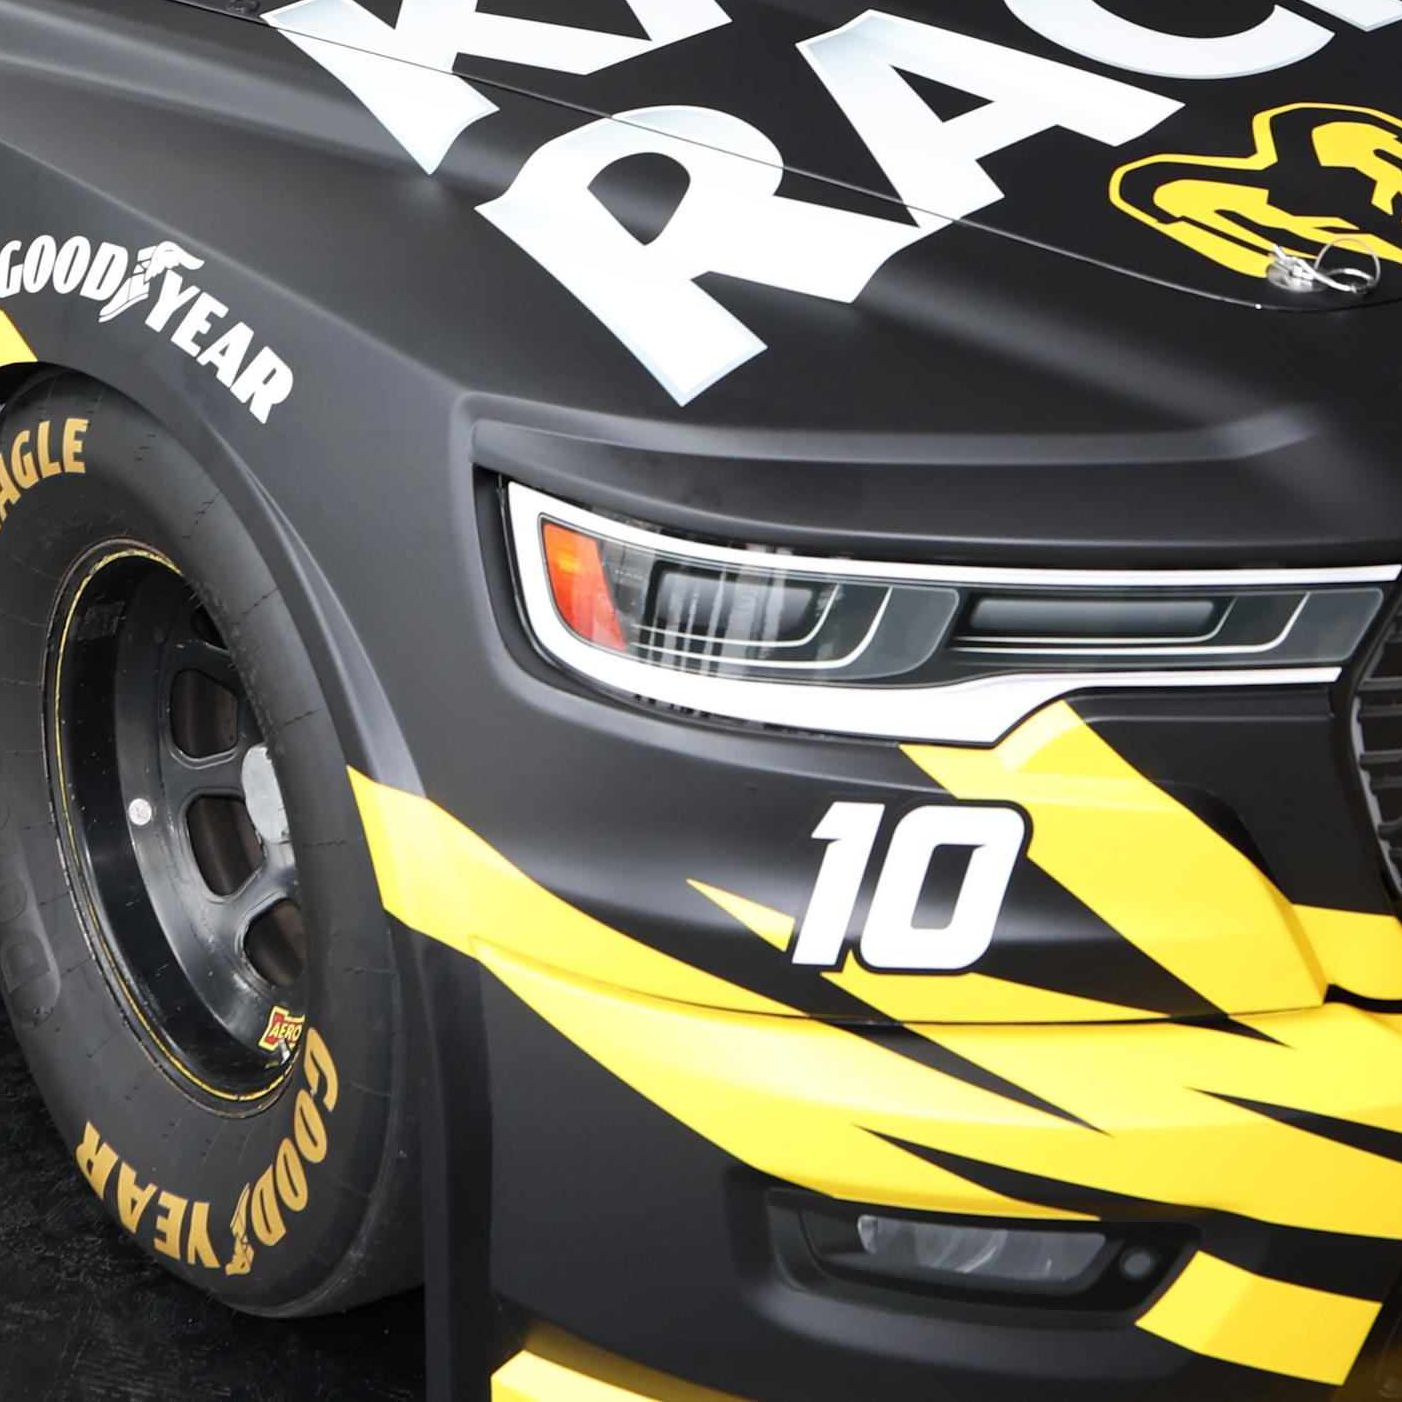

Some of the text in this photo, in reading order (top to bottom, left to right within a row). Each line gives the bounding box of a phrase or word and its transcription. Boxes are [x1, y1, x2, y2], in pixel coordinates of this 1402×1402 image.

[142, 272, 295, 425] YEAR
[791, 800, 1026, 970] 10
[268, 1021, 303, 1043] AERO
[75, 1026, 340, 1270] GOOD YEAR
